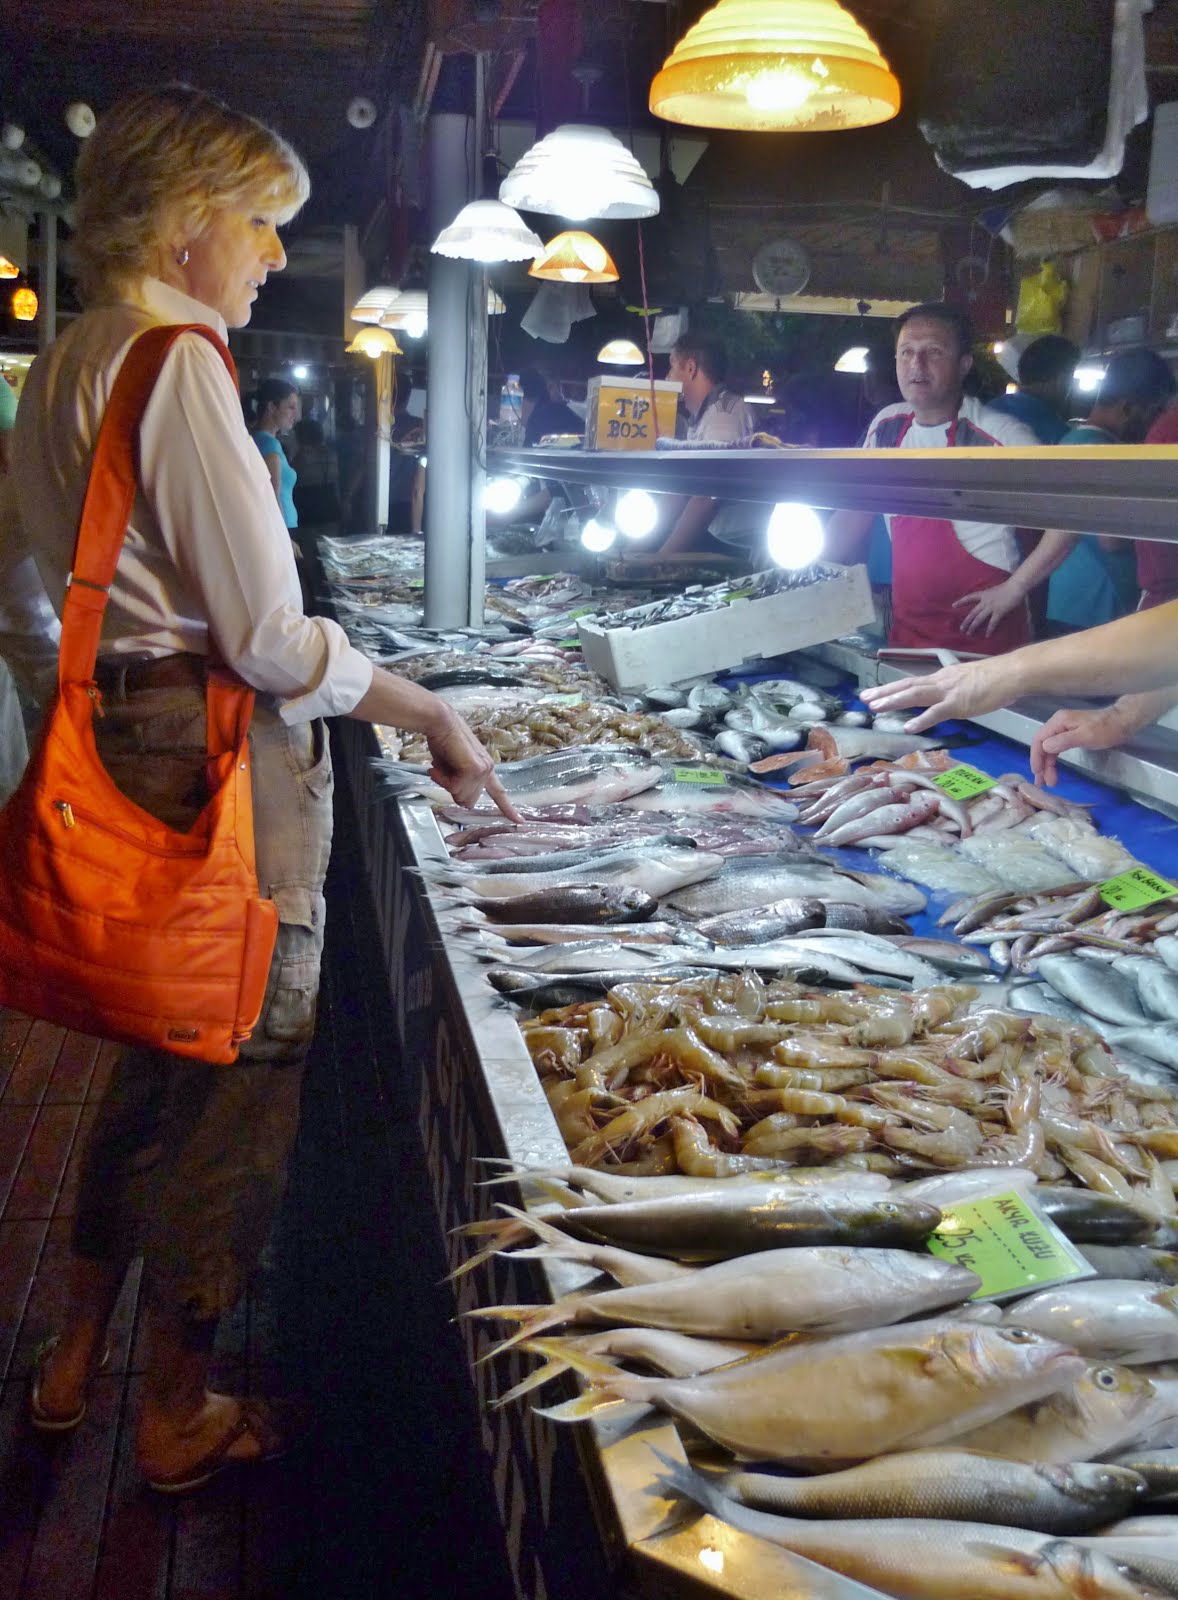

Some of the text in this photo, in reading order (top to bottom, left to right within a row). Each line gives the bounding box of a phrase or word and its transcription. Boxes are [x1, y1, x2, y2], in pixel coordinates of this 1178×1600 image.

[607, 419, 648, 438] BOX
[930, 1227, 982, 1249] 25
[1018, 1230, 1056, 1260] KUZU
